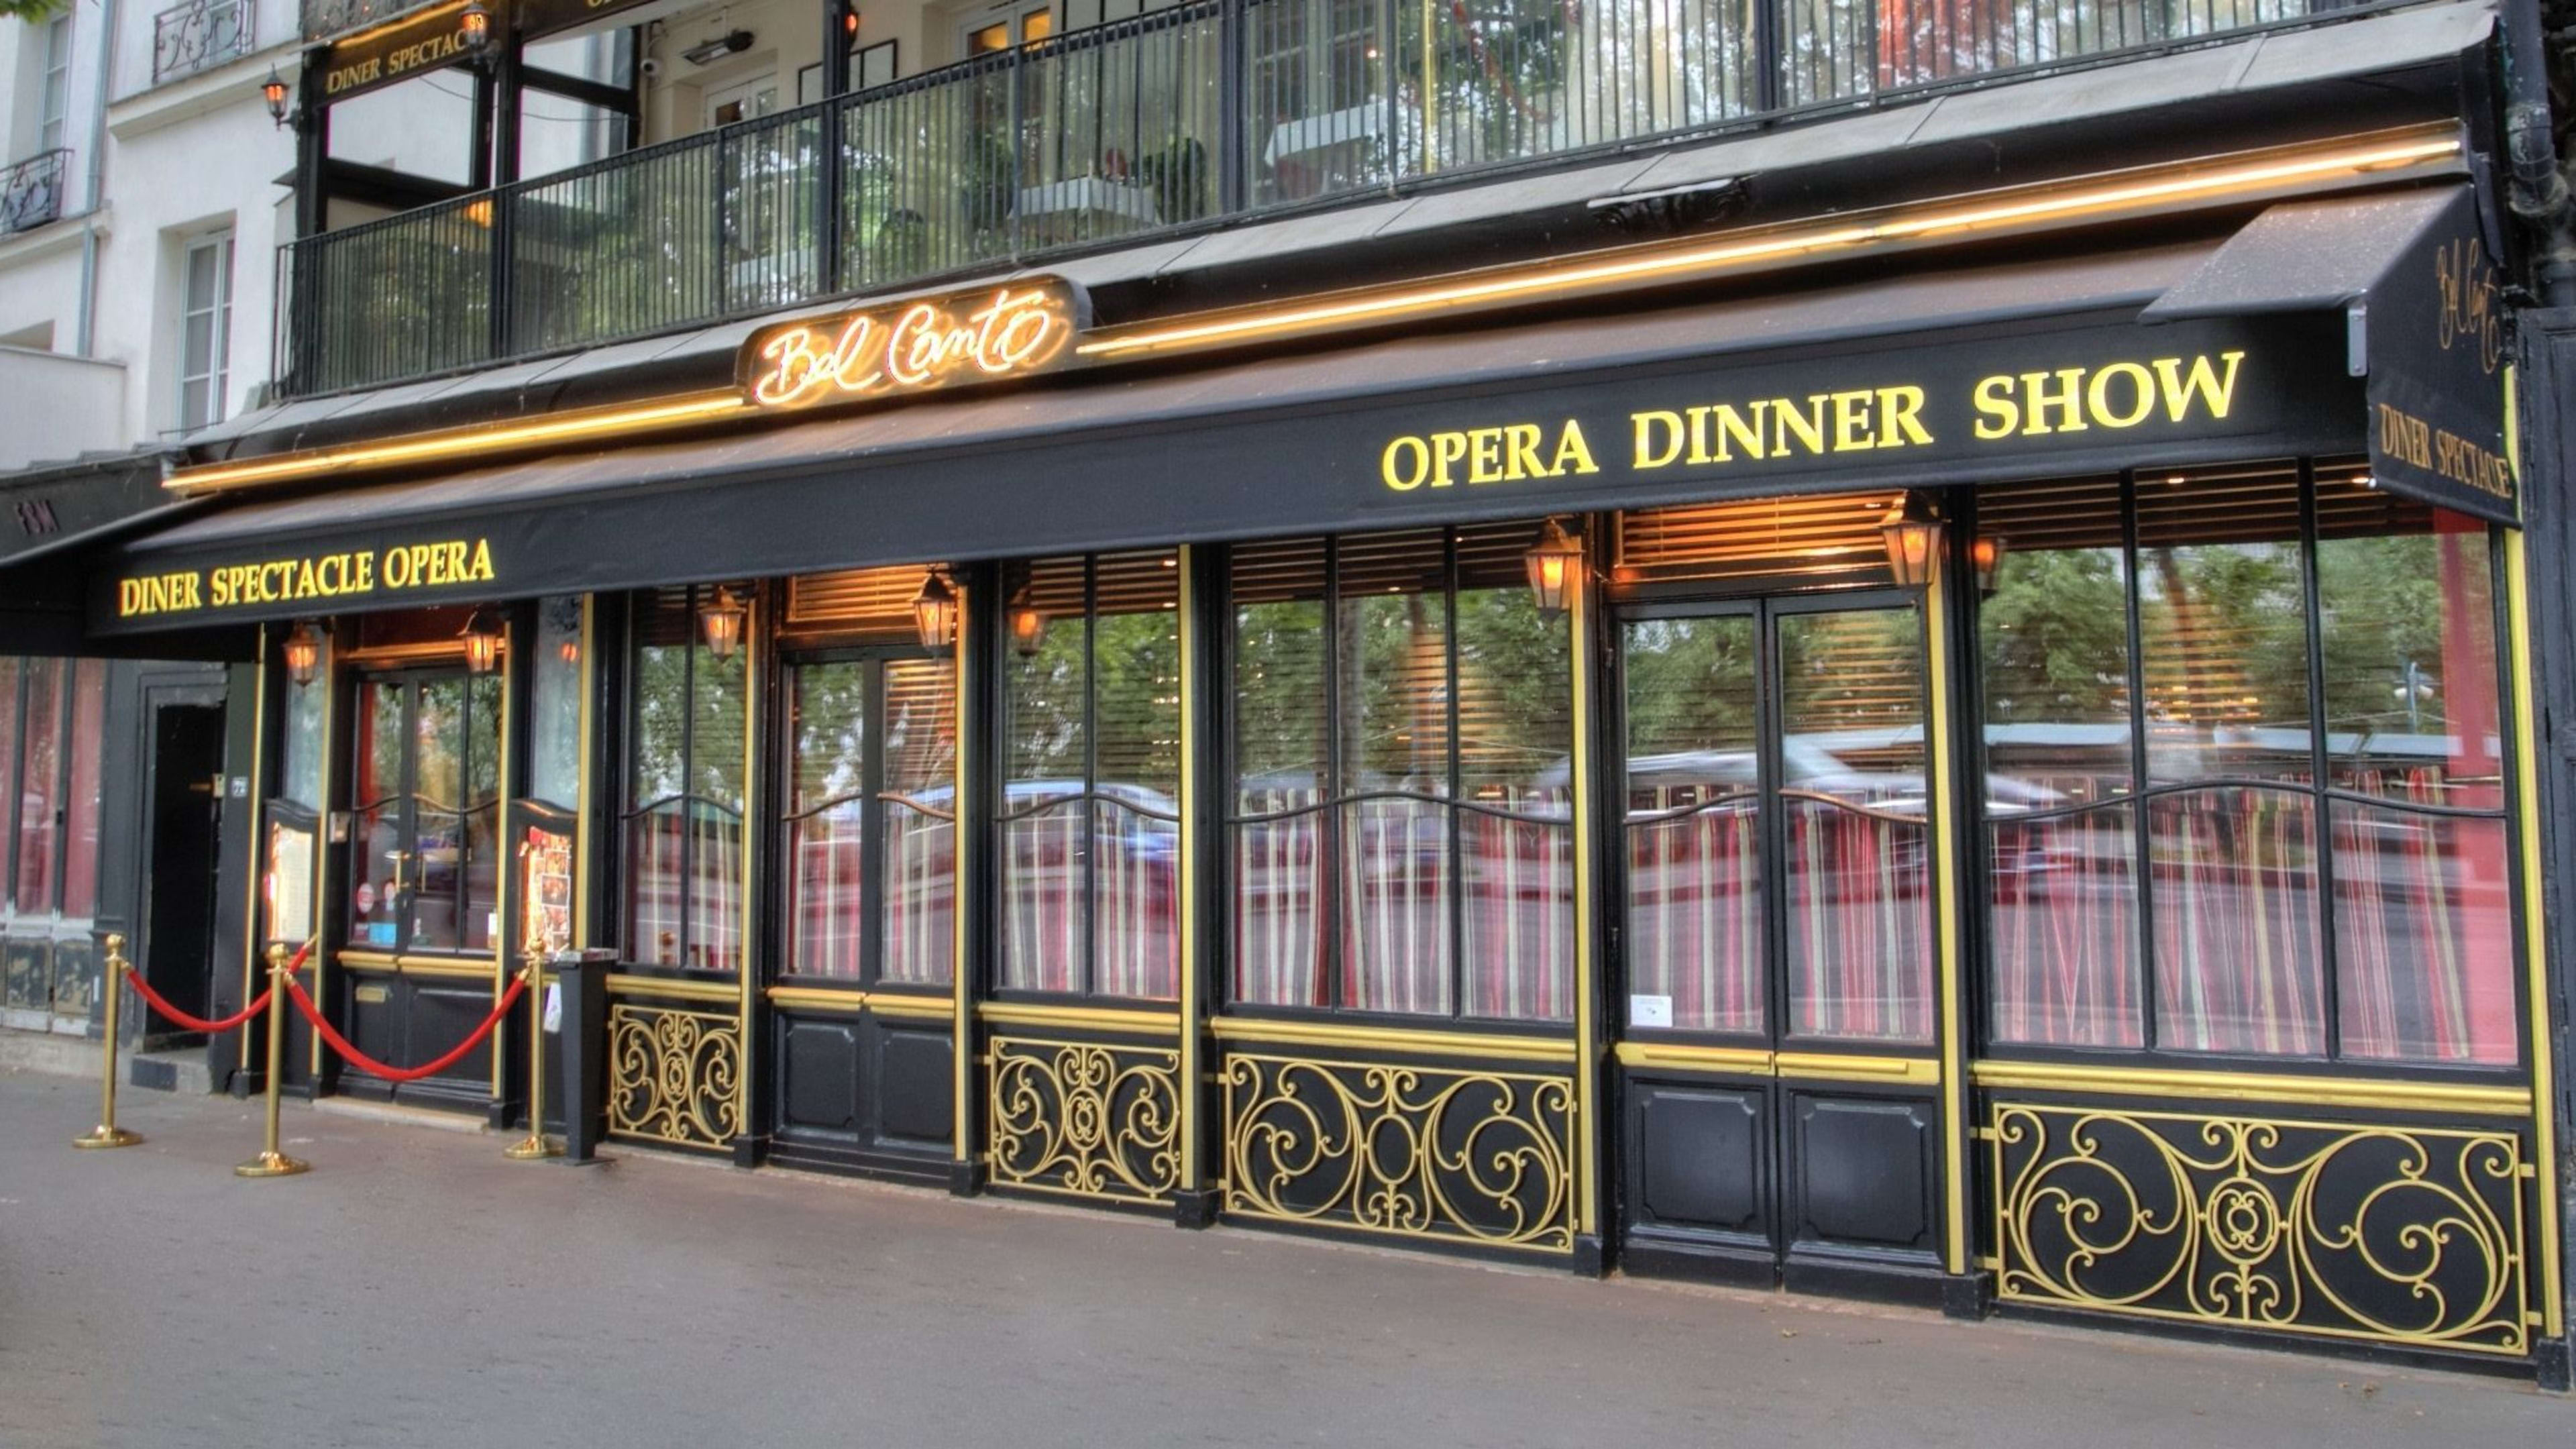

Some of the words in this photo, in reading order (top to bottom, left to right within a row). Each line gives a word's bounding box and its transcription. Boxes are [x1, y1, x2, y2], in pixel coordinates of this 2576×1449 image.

[327, 58, 380, 94] DINER
[388, 29, 471, 75] SPECTAC
[888, 290, 1051, 384] Canto
[1381, 419, 1599, 491] OPERA
[1630, 384, 1935, 469] DINNER
[1973, 351, 2246, 439] SHOW
[2379, 403, 2432, 470] DINER
[2436, 429, 2514, 499] SPECTACLE
[120, 572, 203, 617] DINER
[211, 551, 374, 606] SPECTACLE
[383, 538, 495, 589] OPERA
